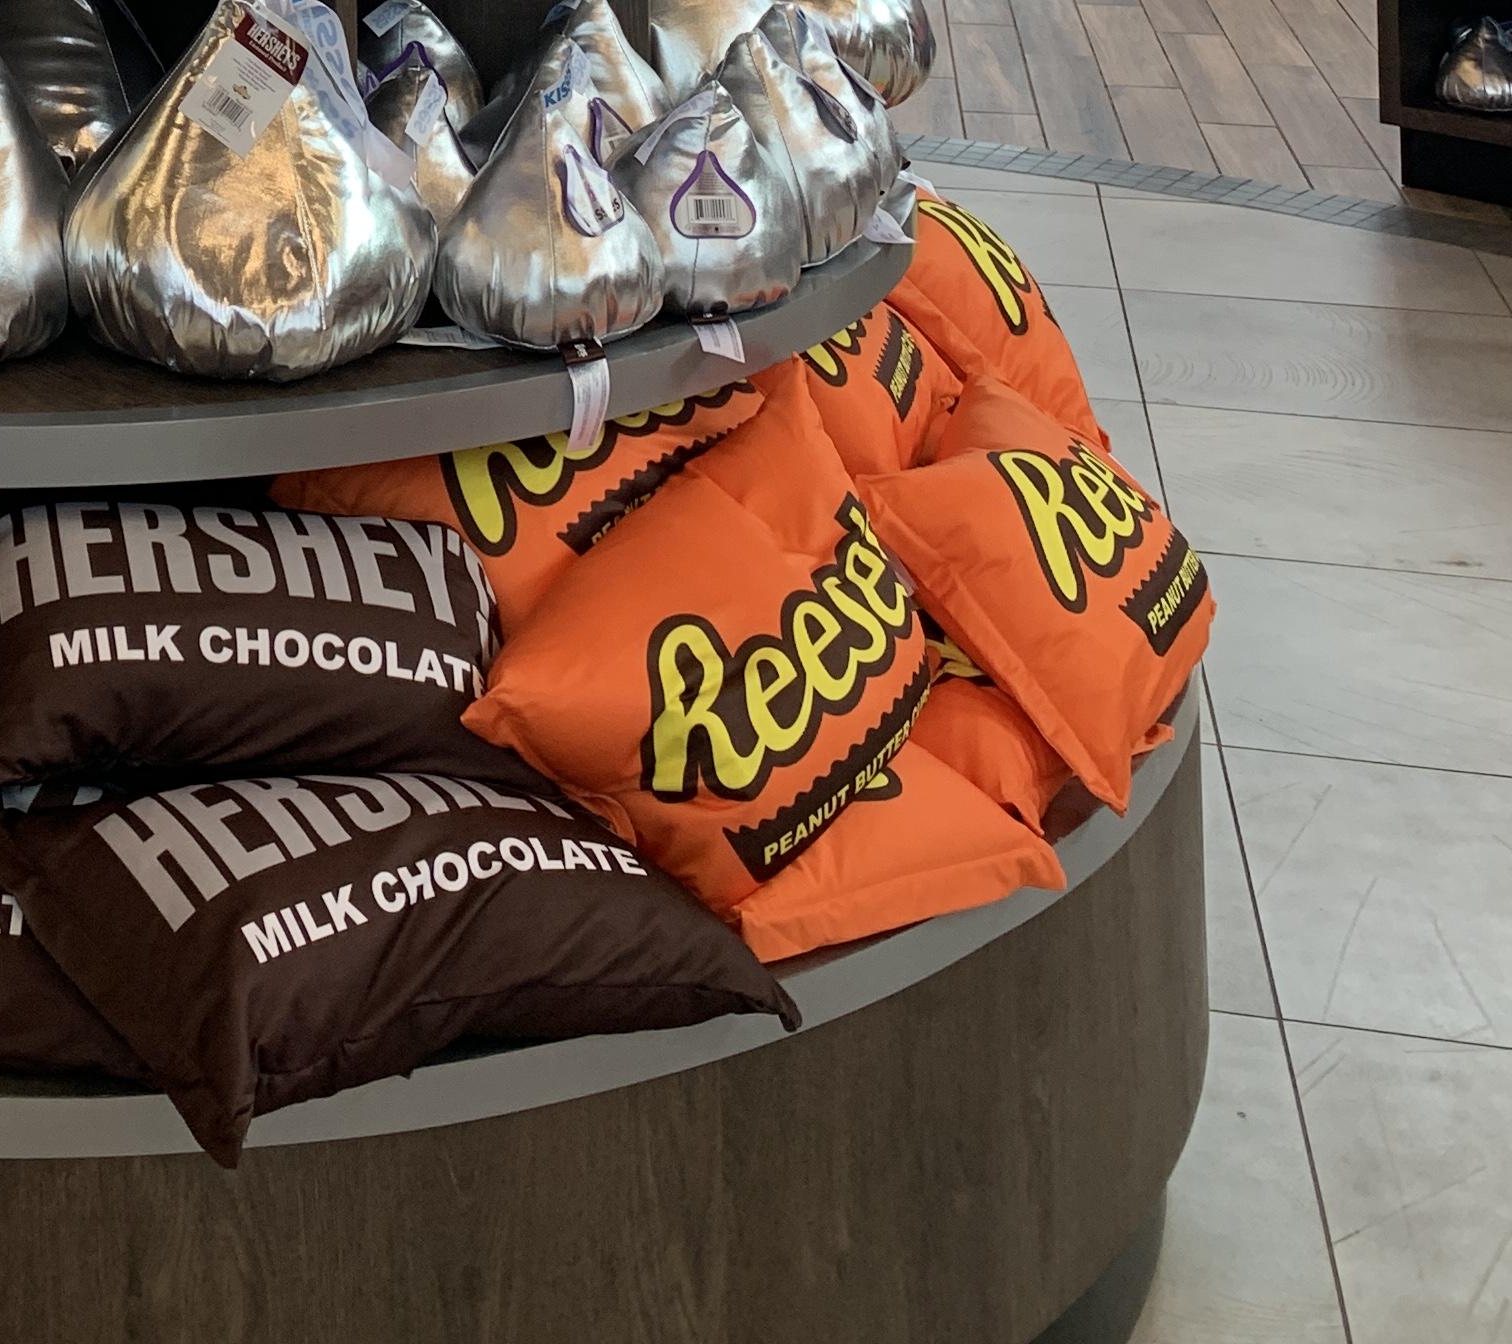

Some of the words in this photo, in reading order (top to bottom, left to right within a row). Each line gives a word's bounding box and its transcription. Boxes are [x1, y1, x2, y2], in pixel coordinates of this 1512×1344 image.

[247, 23, 302, 71] HERSHEY'S
[49, 624, 185, 669] MILK
[651, 507, 908, 792] Reese'
[1147, 575, 1188, 636] PEANUT
[763, 783, 850, 866] PEANUT
[854, 718, 913, 796] BUTTER
[240, 883, 369, 965] MILK
[371, 836, 648, 914] CHOCOLATE
